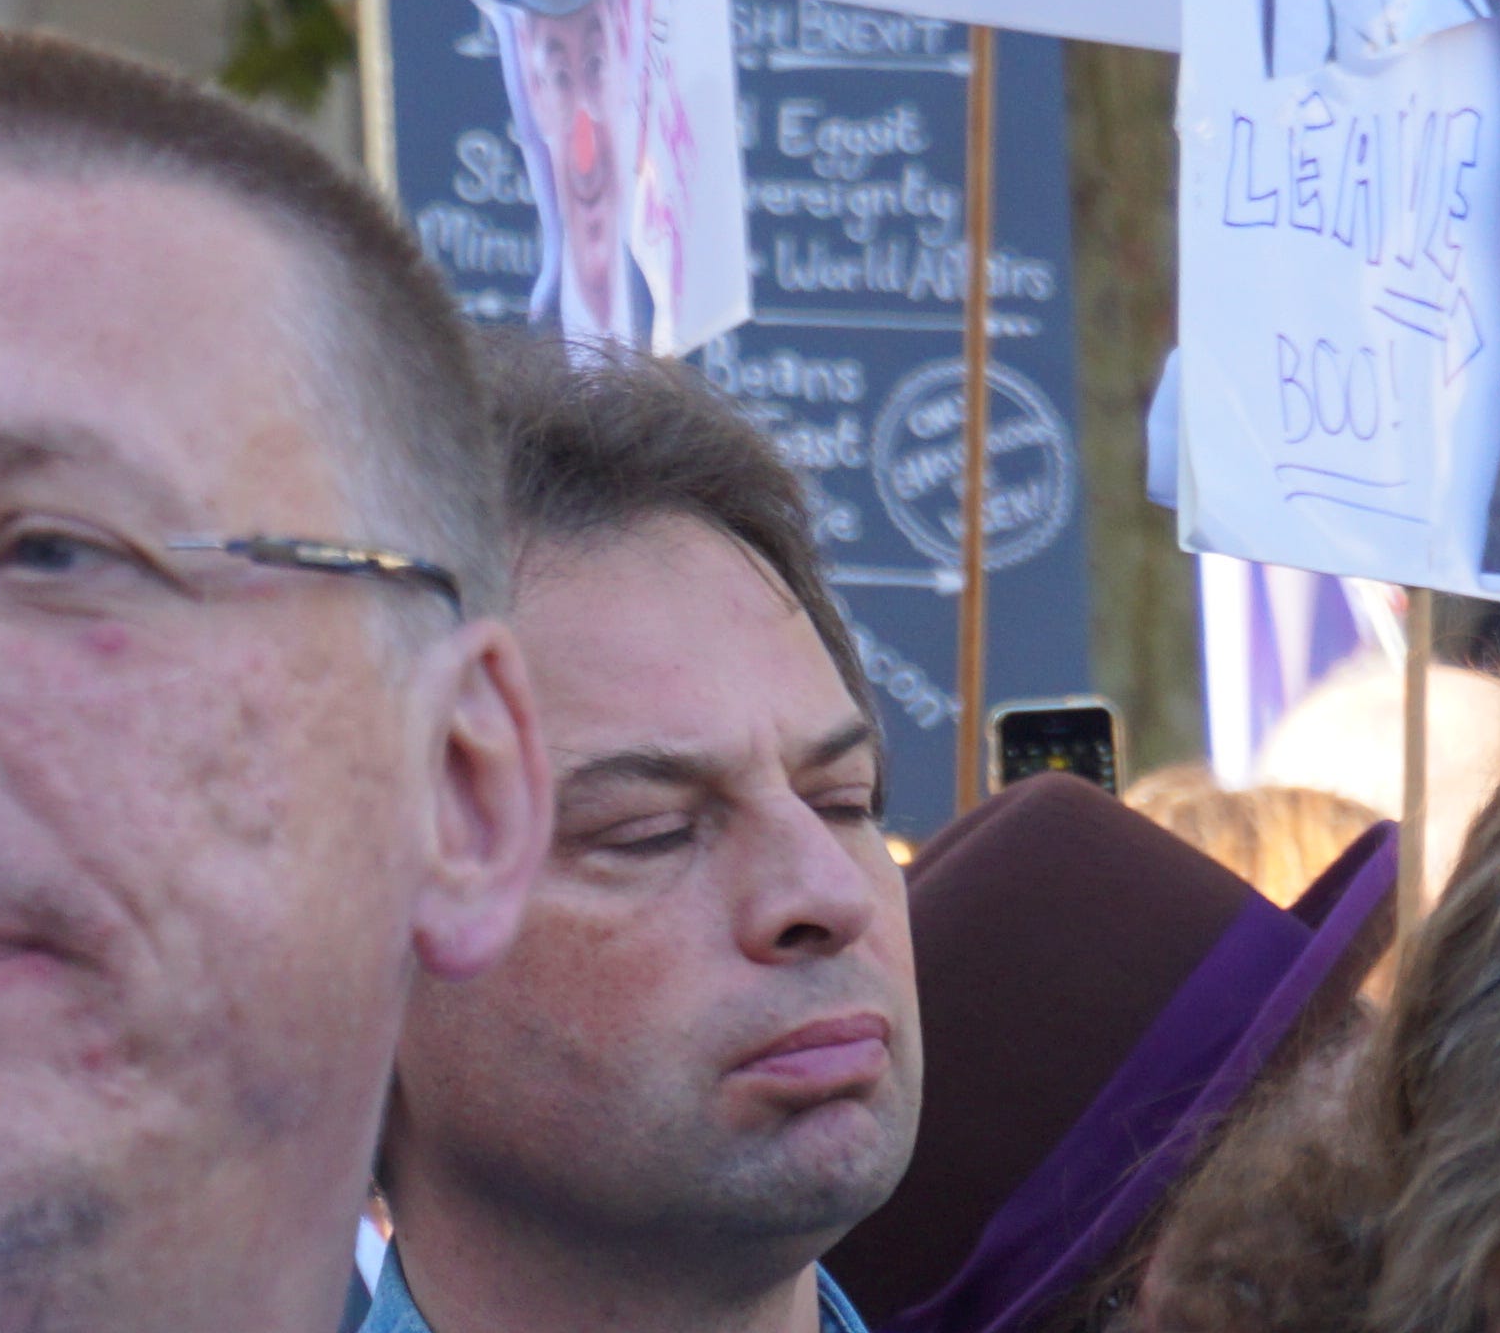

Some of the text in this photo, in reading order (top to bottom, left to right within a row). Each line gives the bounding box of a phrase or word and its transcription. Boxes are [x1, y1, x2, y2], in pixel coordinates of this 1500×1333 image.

[1222, 90, 1483, 282] LEAVE
[775, 234, 904, 293] World
[1276, 333, 1404, 444] BOO!
